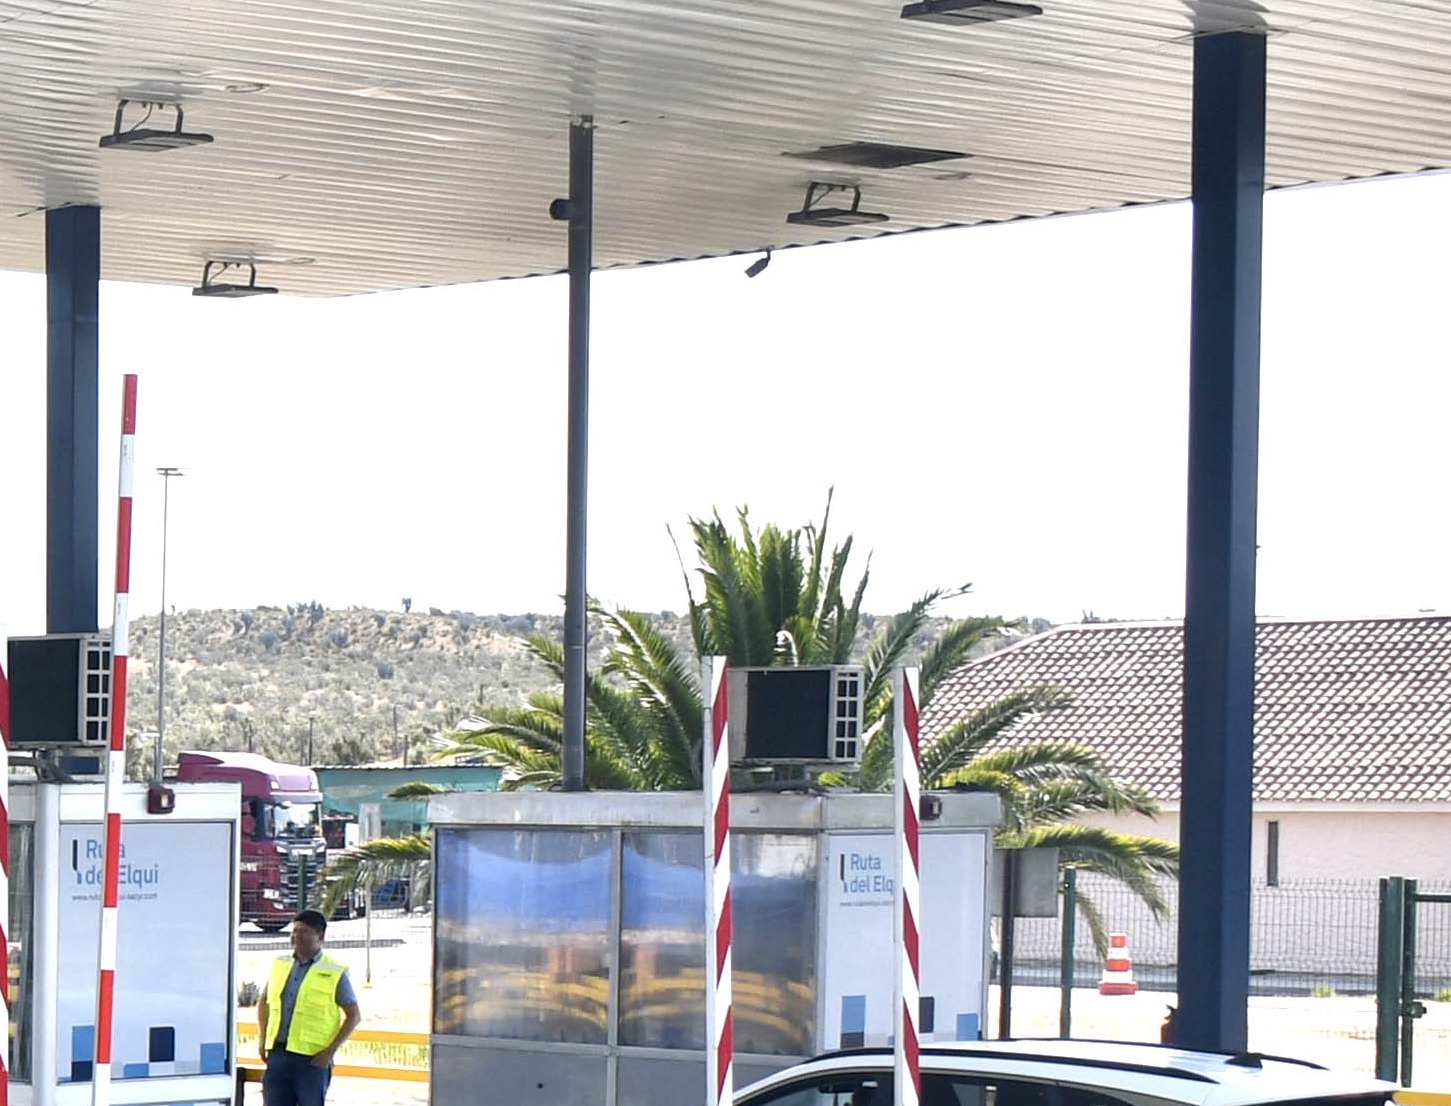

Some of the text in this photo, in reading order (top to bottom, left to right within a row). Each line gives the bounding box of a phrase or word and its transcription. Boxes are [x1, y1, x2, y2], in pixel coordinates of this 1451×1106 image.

[86, 839, 126, 859] Rua
[850, 853, 881, 871] Ruta
[85, 863, 159, 889] de Elqui
[850, 875, 895, 897] del Elq
